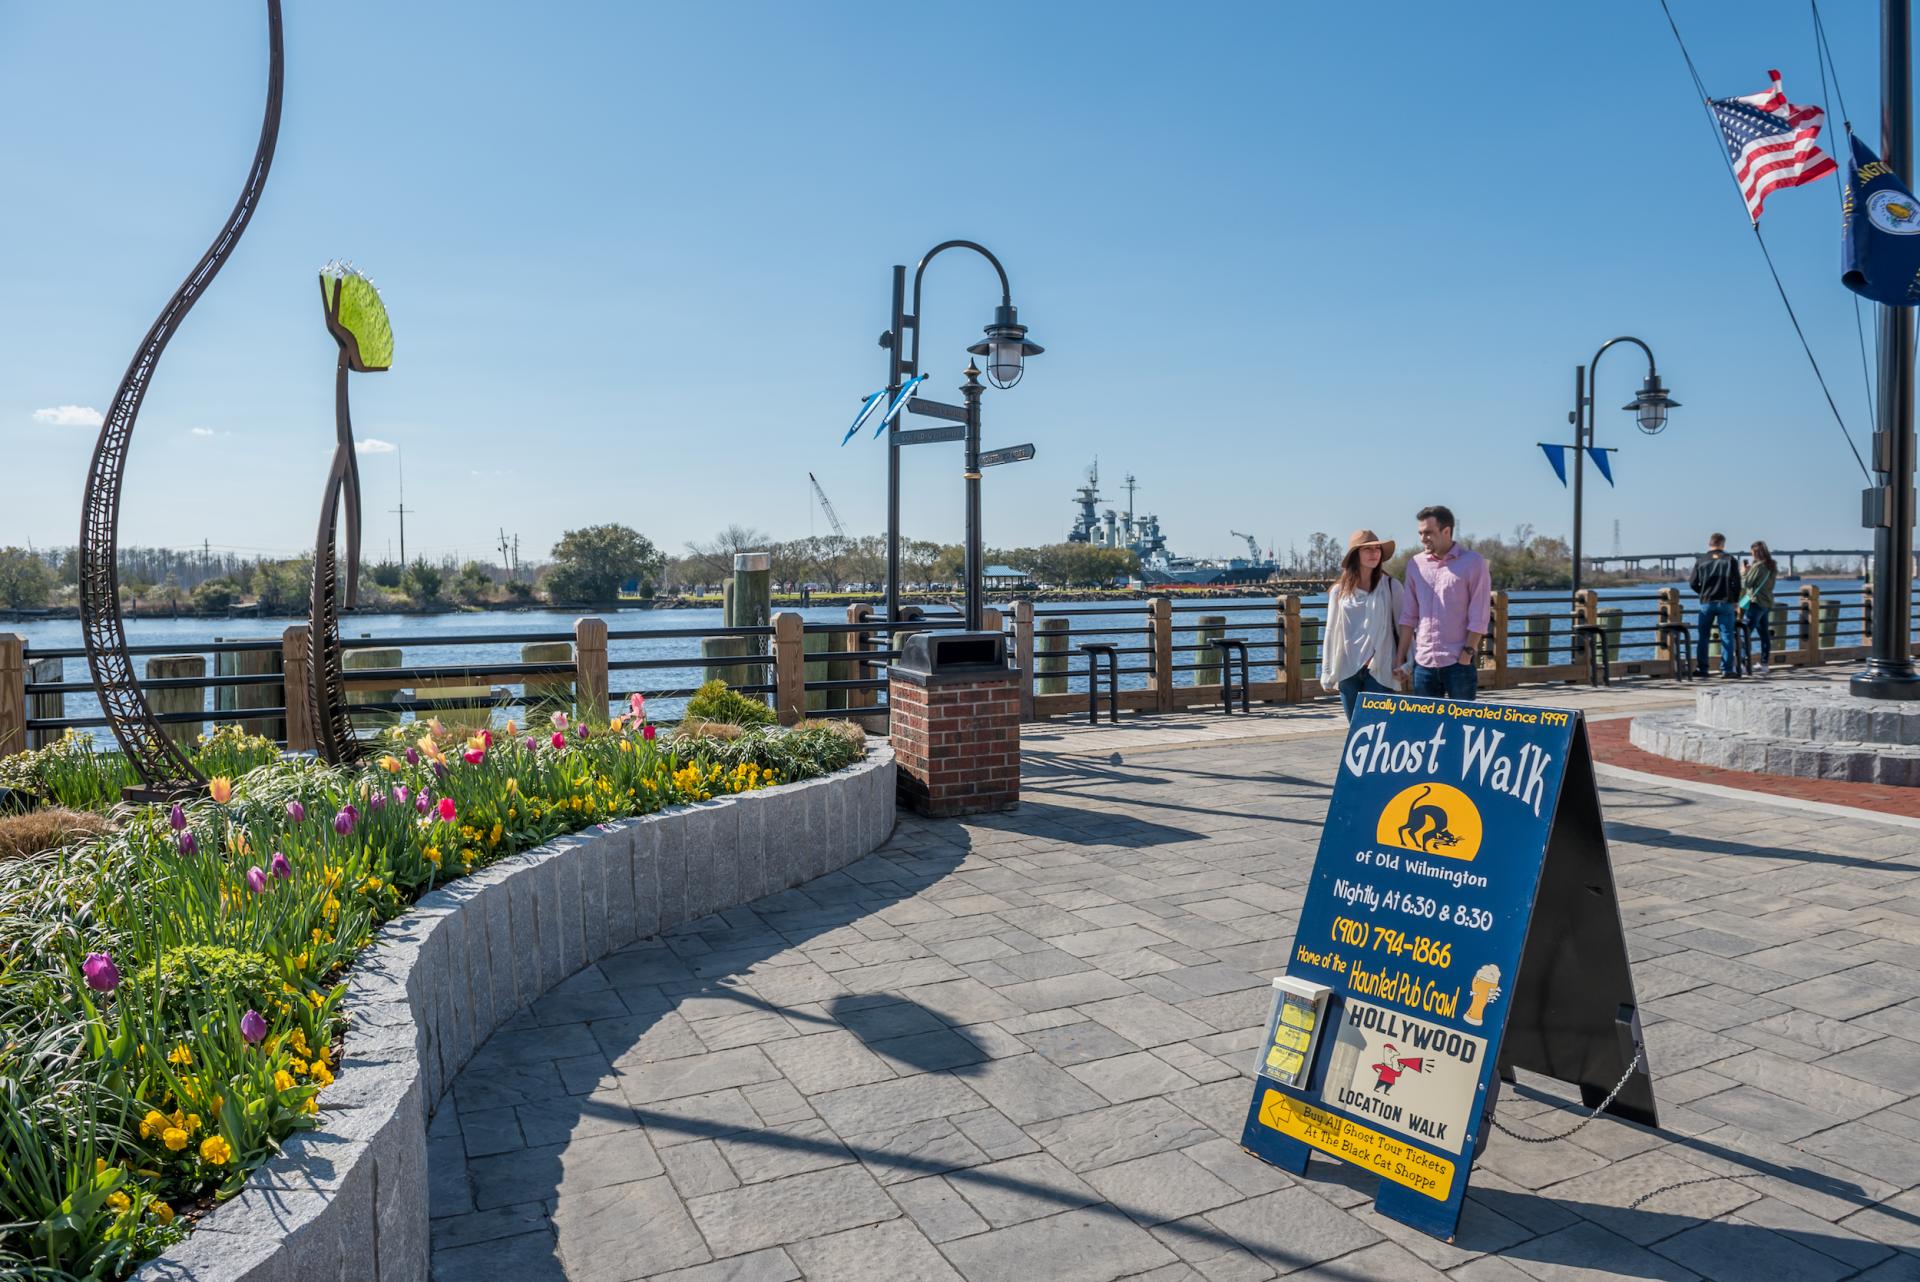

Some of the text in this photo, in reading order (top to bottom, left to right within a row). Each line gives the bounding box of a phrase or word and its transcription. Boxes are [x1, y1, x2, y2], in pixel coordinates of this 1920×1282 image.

[1362, 697, 1569, 727] Locally Owned & Operated Since 1999
[1345, 721, 1552, 818] Ghost Walk
[1355, 850, 1488, 888] of Old Wilmington
[1333, 878, 1493, 931] Nightly At 6:30 & 8:30
[1331, 915, 1452, 968] (910) 794-1866
[1297, 945, 1321, 966] Home
[1321, 952, 1333, 968] of
[1331, 956, 1347, 973] the
[1348, 960, 1400, 1001] Haunted
[1397, 972, 1421, 1008] Pub
[1423, 980, 1461, 1019] Crawl
[1349, 1004, 1477, 1064] HOLLYWOOD
[1303, 1106, 1447, 1175] Buy All Ghost Tour Tickets
[1338, 1087, 1448, 1140] LOCATION WALK
[1304, 1125, 1436, 1190] At The Black Cat Shoppe
